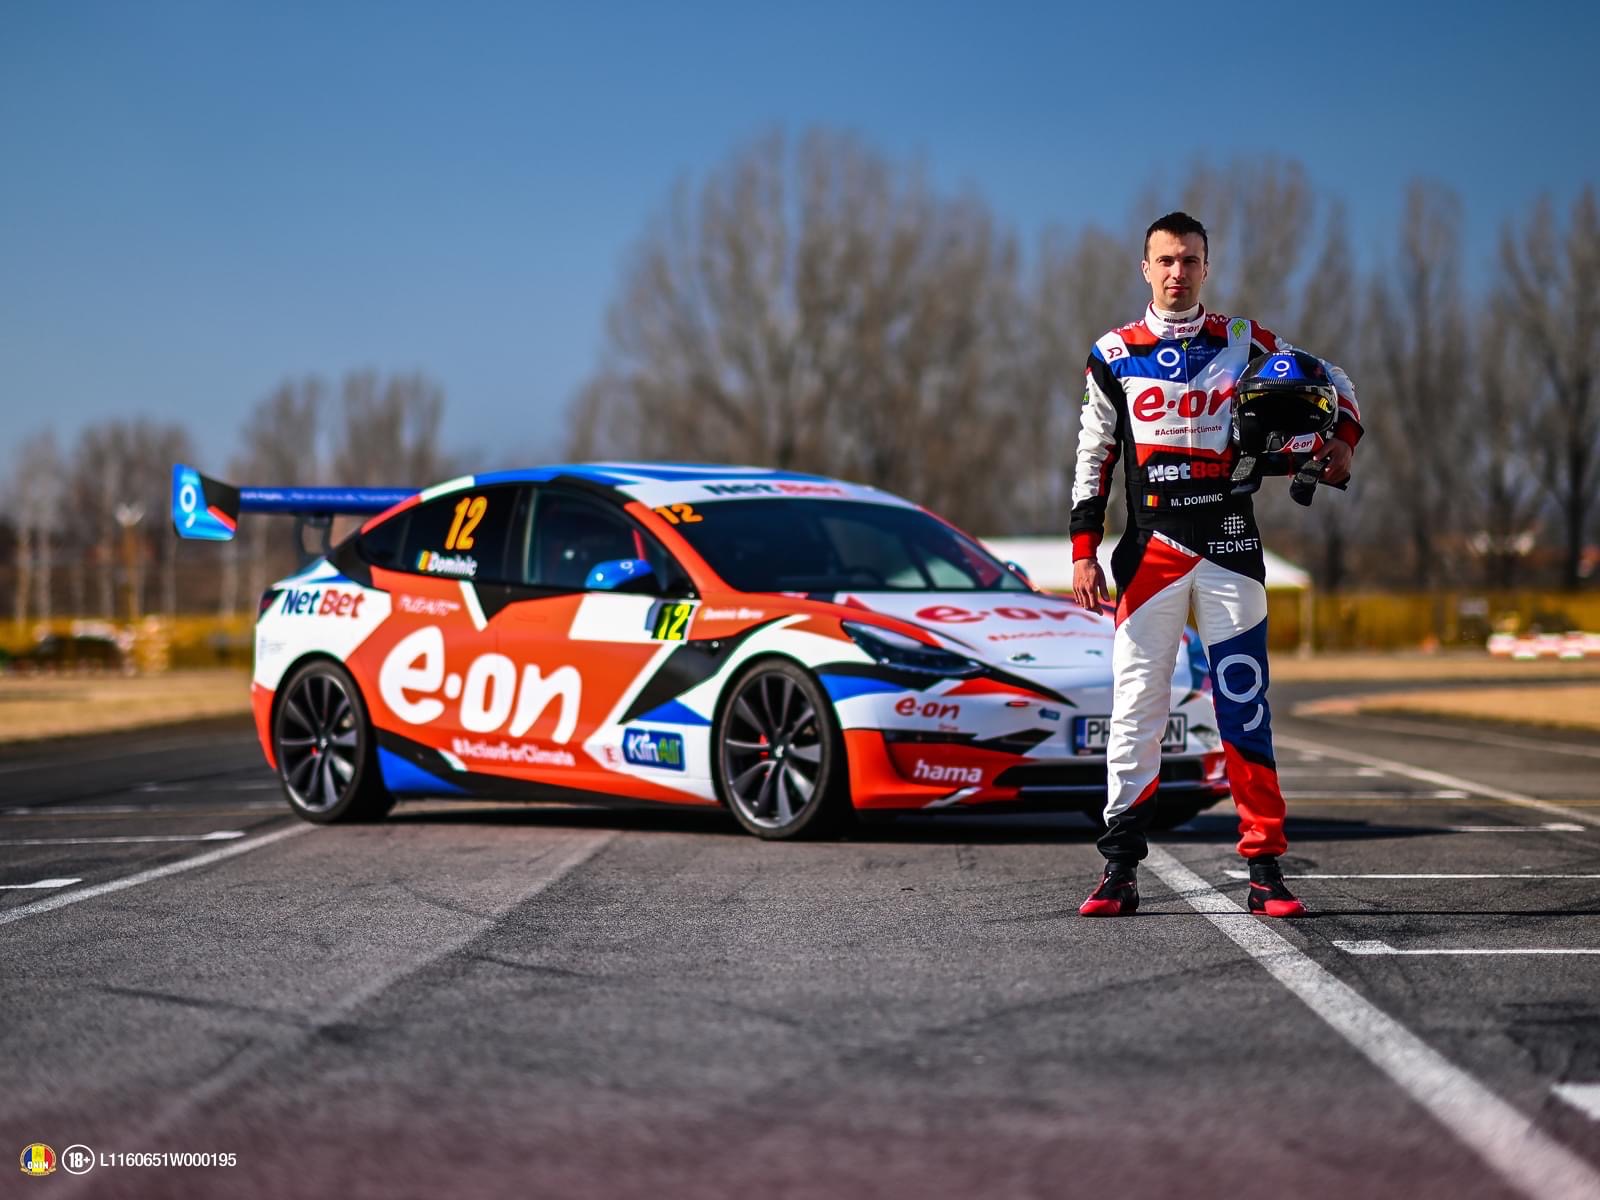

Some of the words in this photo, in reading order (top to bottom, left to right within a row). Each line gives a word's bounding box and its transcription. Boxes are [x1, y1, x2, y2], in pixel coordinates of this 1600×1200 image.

[1155, 424, 1222, 436] #ActionForClimate
[1147, 461, 1231, 482] NetBet
[1170, 498, 1182, 507] M.
[1184, 494, 1223, 506] DOMINIC
[445, 496, 488, 550] 12
[655, 503, 703, 525] 12
[1208, 538, 1259, 554] TECNET
[427, 551, 478, 576] Dominic
[281, 589, 366, 618] NetBet
[658, 603, 691, 640] 12
[913, 759, 982, 784] hama
